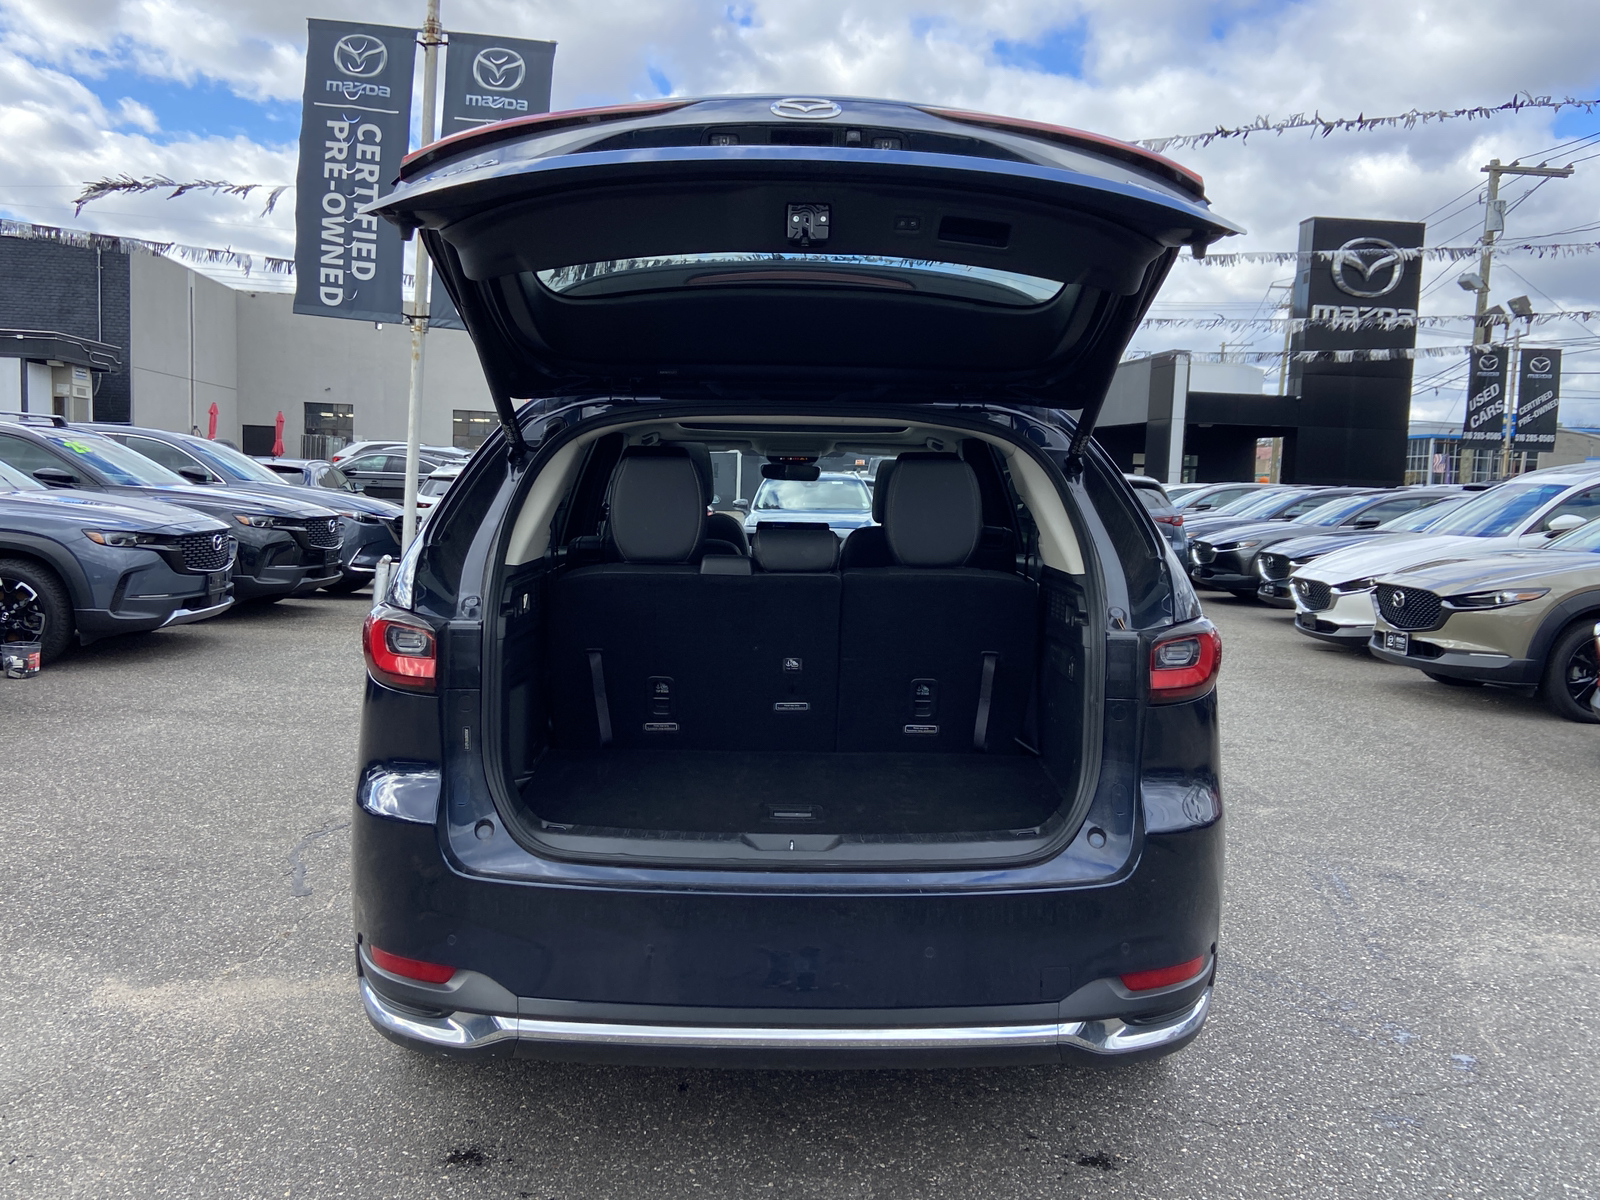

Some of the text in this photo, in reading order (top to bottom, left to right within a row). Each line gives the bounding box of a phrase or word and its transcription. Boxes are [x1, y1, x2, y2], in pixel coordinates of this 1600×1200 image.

[319, 120, 351, 307] PRE-OWNED
[1468, 383, 1500, 411] USED
[1519, 390, 1553, 415] CERTIFIED
[1470, 400, 1504, 428] CARS
[1518, 398, 1559, 427] PRE-OWNED
